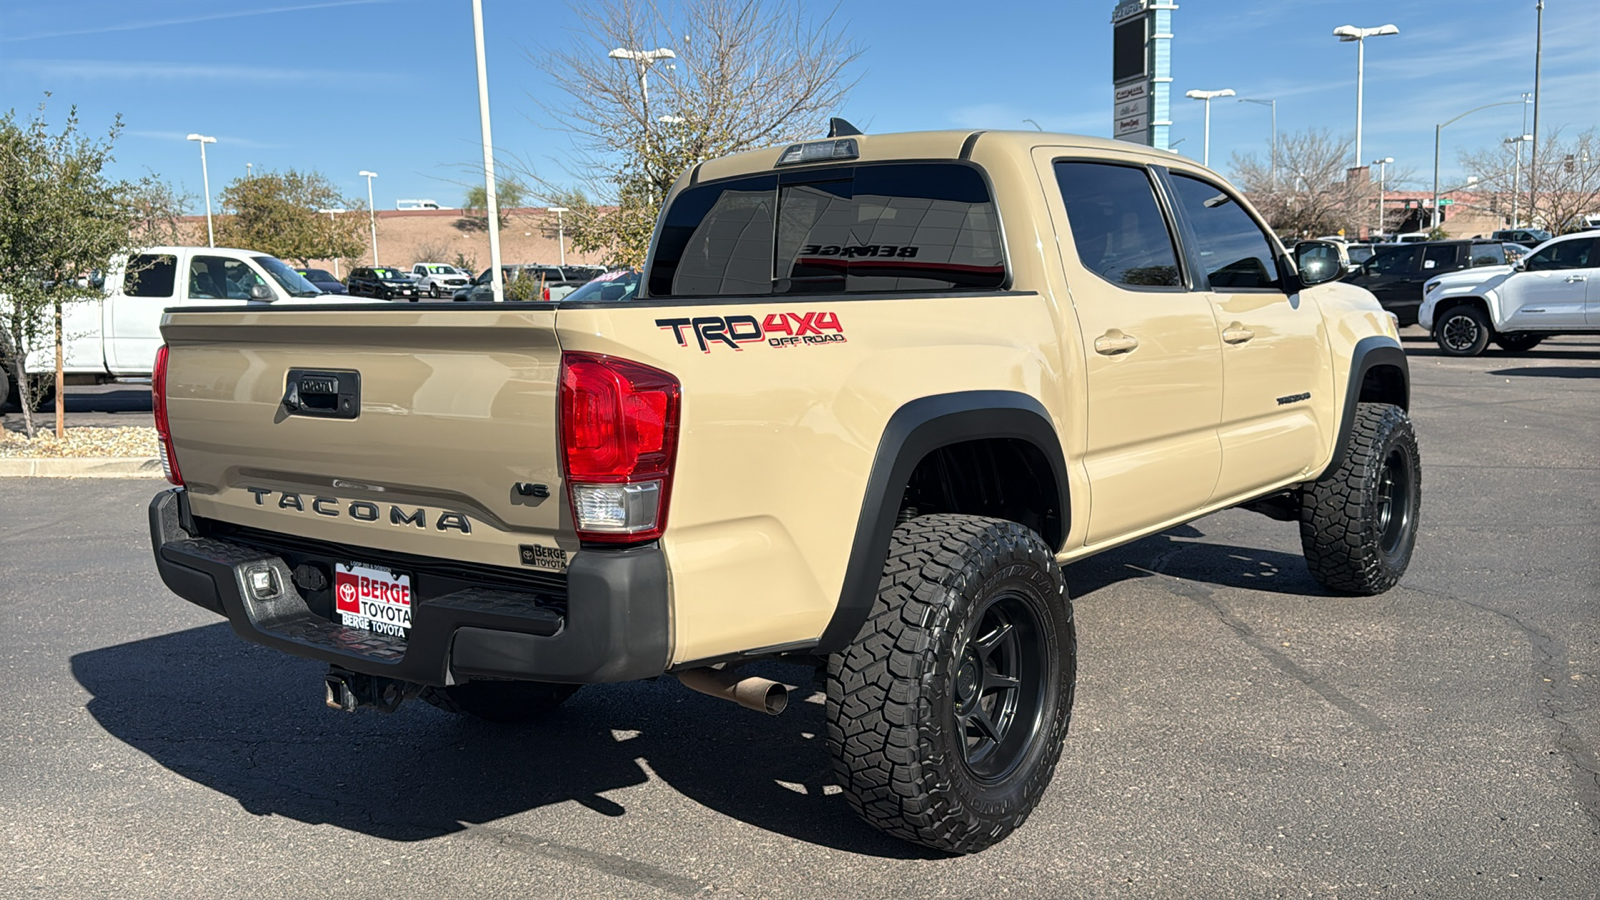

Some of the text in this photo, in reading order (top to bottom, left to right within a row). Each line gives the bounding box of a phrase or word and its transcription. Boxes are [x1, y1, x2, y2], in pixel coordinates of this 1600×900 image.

[655, 312, 843, 353] TRD 4X4
[768, 334, 847, 348] OFF ROAD
[515, 482, 550, 498] V6
[247, 486, 472, 535] TACOMA
[534, 544, 566, 560] BERGE
[535, 558, 567, 569] TOYOTA
[360, 576, 410, 605] BERGE
[361, 601, 412, 624] TOYOTA
[342, 613, 405, 638] BERGE TOYOTA
